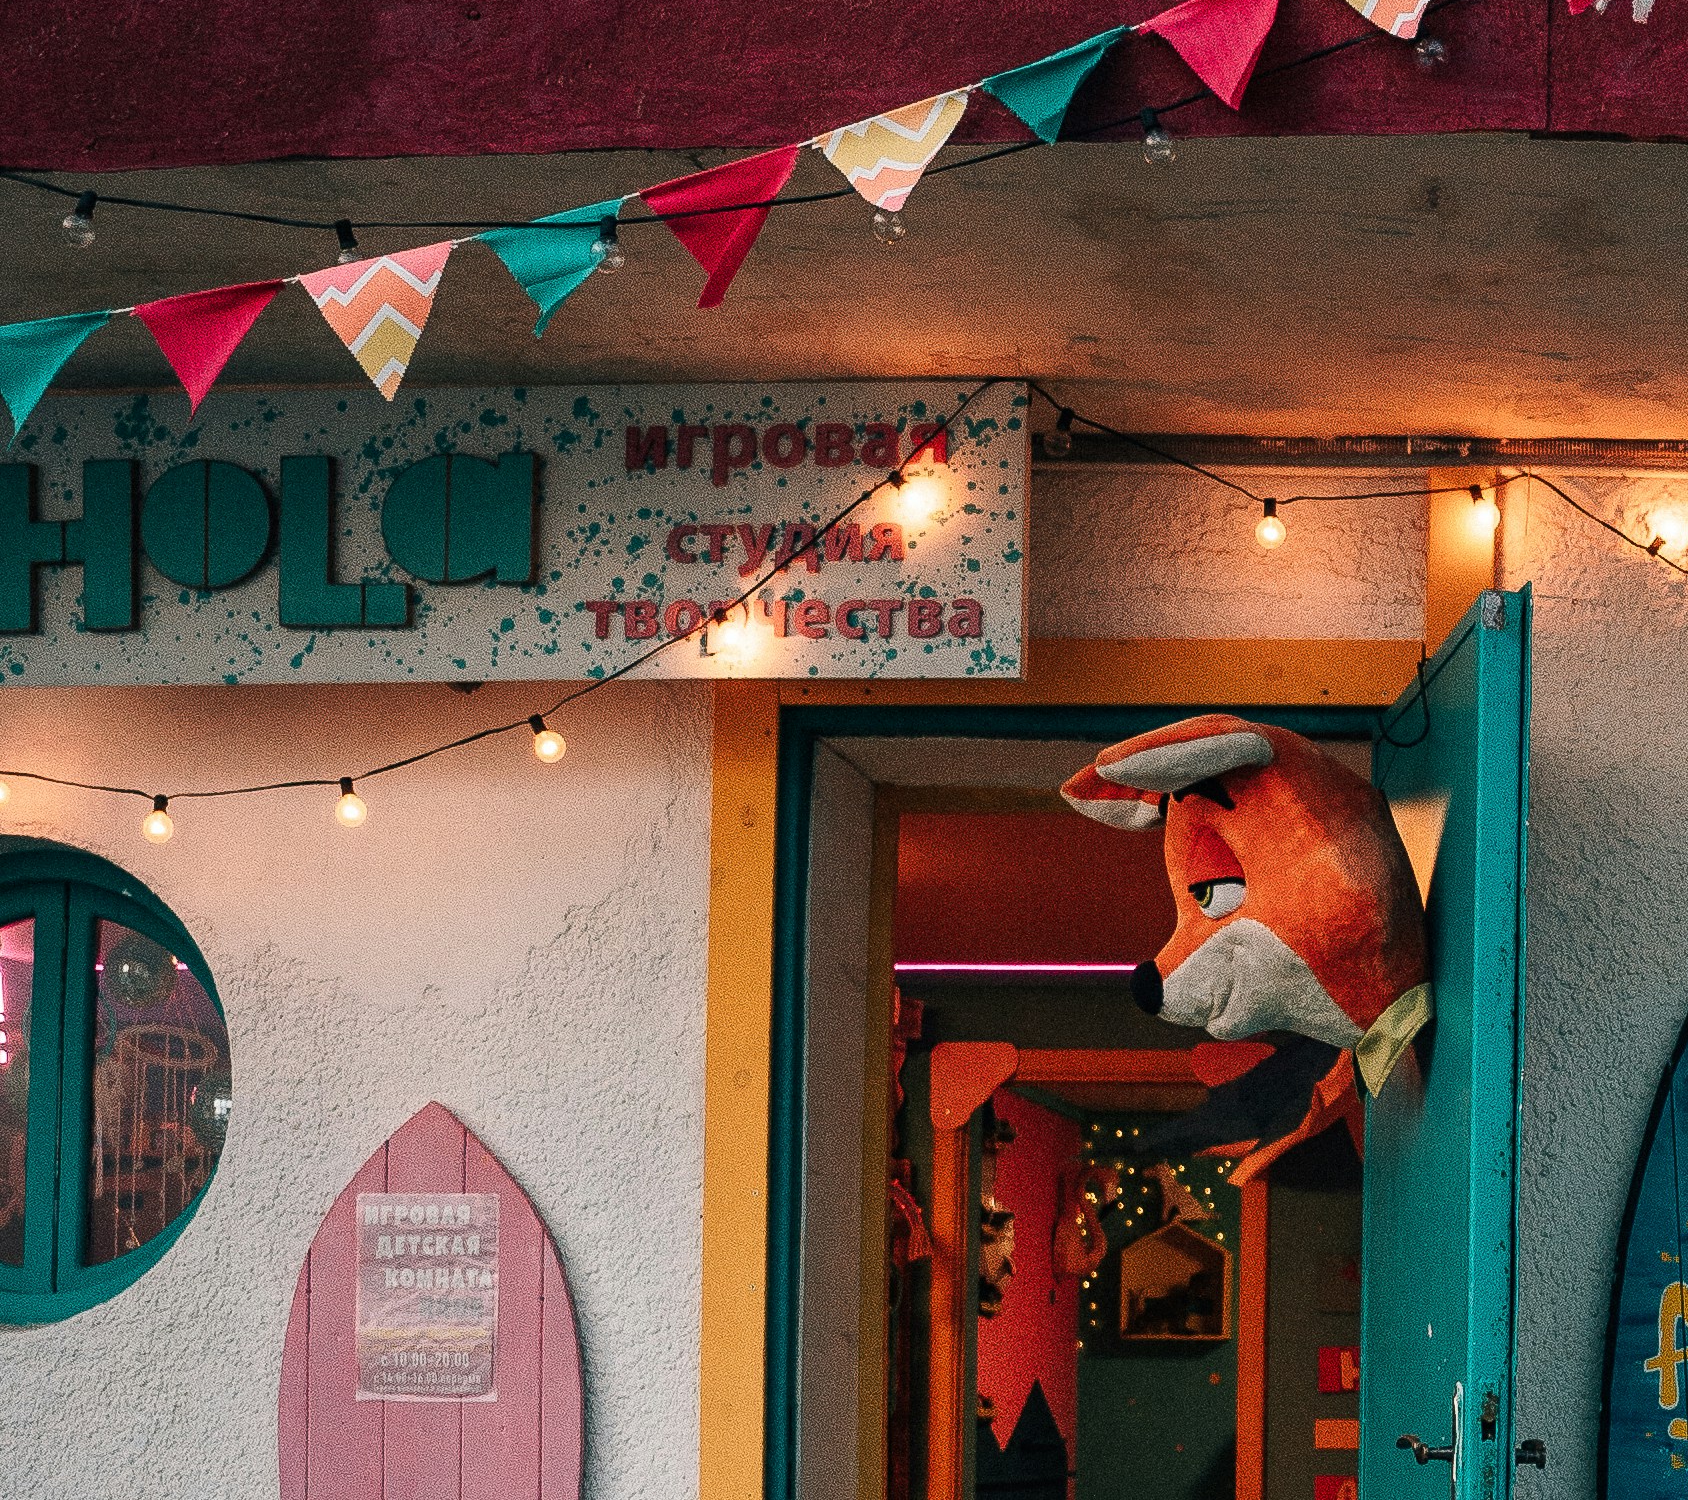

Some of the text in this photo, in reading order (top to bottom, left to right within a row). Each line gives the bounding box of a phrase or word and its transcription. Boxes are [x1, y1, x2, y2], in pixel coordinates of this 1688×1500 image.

[625, 422, 949, 487] игровая
[666, 522, 906, 578] студия
[364, 1204, 471, 1226] ИГРОВАЯ
[375, 1234, 481, 1259] ДЕТСКАЯ
[384, 1267, 494, 1290] КОМНАТА
